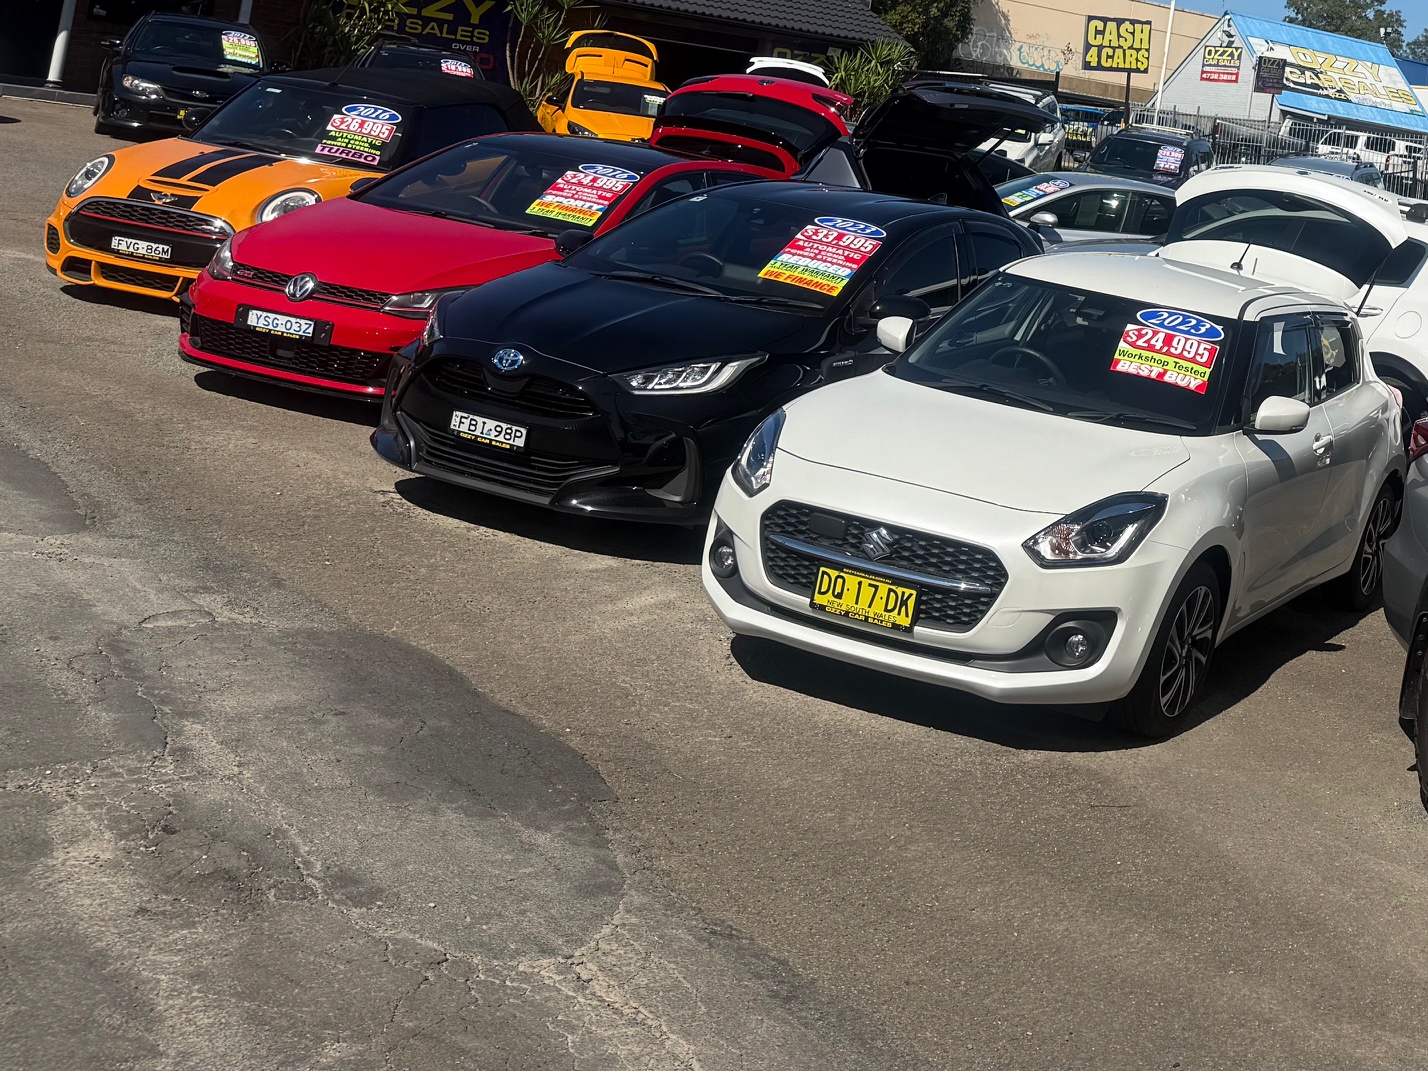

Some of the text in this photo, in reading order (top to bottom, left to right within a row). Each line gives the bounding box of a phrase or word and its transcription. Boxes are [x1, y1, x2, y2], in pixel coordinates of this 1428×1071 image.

[405, 18, 491, 44] SALES
[452, 43, 481, 53] OVER
[1086, 47, 1098, 66] 4
[1205, 47, 1242, 59] OZZY
[1261, 57, 1284, 68] OZZY
[1289, 46, 1382, 82] OZZY
[1285, 67, 1339, 90] CAR
[1339, 77, 1418, 105] SALES
[350, 107, 392, 120] 2016
[331, 117, 391, 139] $26,995
[329, 131, 382, 146] AUTOMATIC
[318, 145, 377, 162] TURBO
[564, 172, 626, 191] $24,995
[587, 167, 629, 179] 2016
[556, 184, 613, 197] AUTOMATIC
[535, 200, 597, 217] WE FINANCE
[543, 195, 604, 210] SPORTY
[823, 219, 877, 234] 2023
[804, 228, 876, 252] $33,995
[784, 248, 859, 269] POWER STEERING
[795, 241, 862, 260] AUTOMATIC
[777, 254, 852, 276] REDUCED
[779, 262, 799, 271] YEAR
[762, 269, 787, 279] WE
[784, 273, 839, 293] FINANCE
[1148, 312, 1211, 334] 2023
[283, 332, 300, 340] SALES
[1126, 329, 1212, 363] $24,995
[1118, 349, 1207, 378] Workshop Tested
[1116, 360, 1204, 390] BEST BUY
[491, 440, 511, 449] SALES
[825, 606, 892, 628] OZZY CAR SALES
[827, 599, 898, 624] NEW SOUTH WALES
